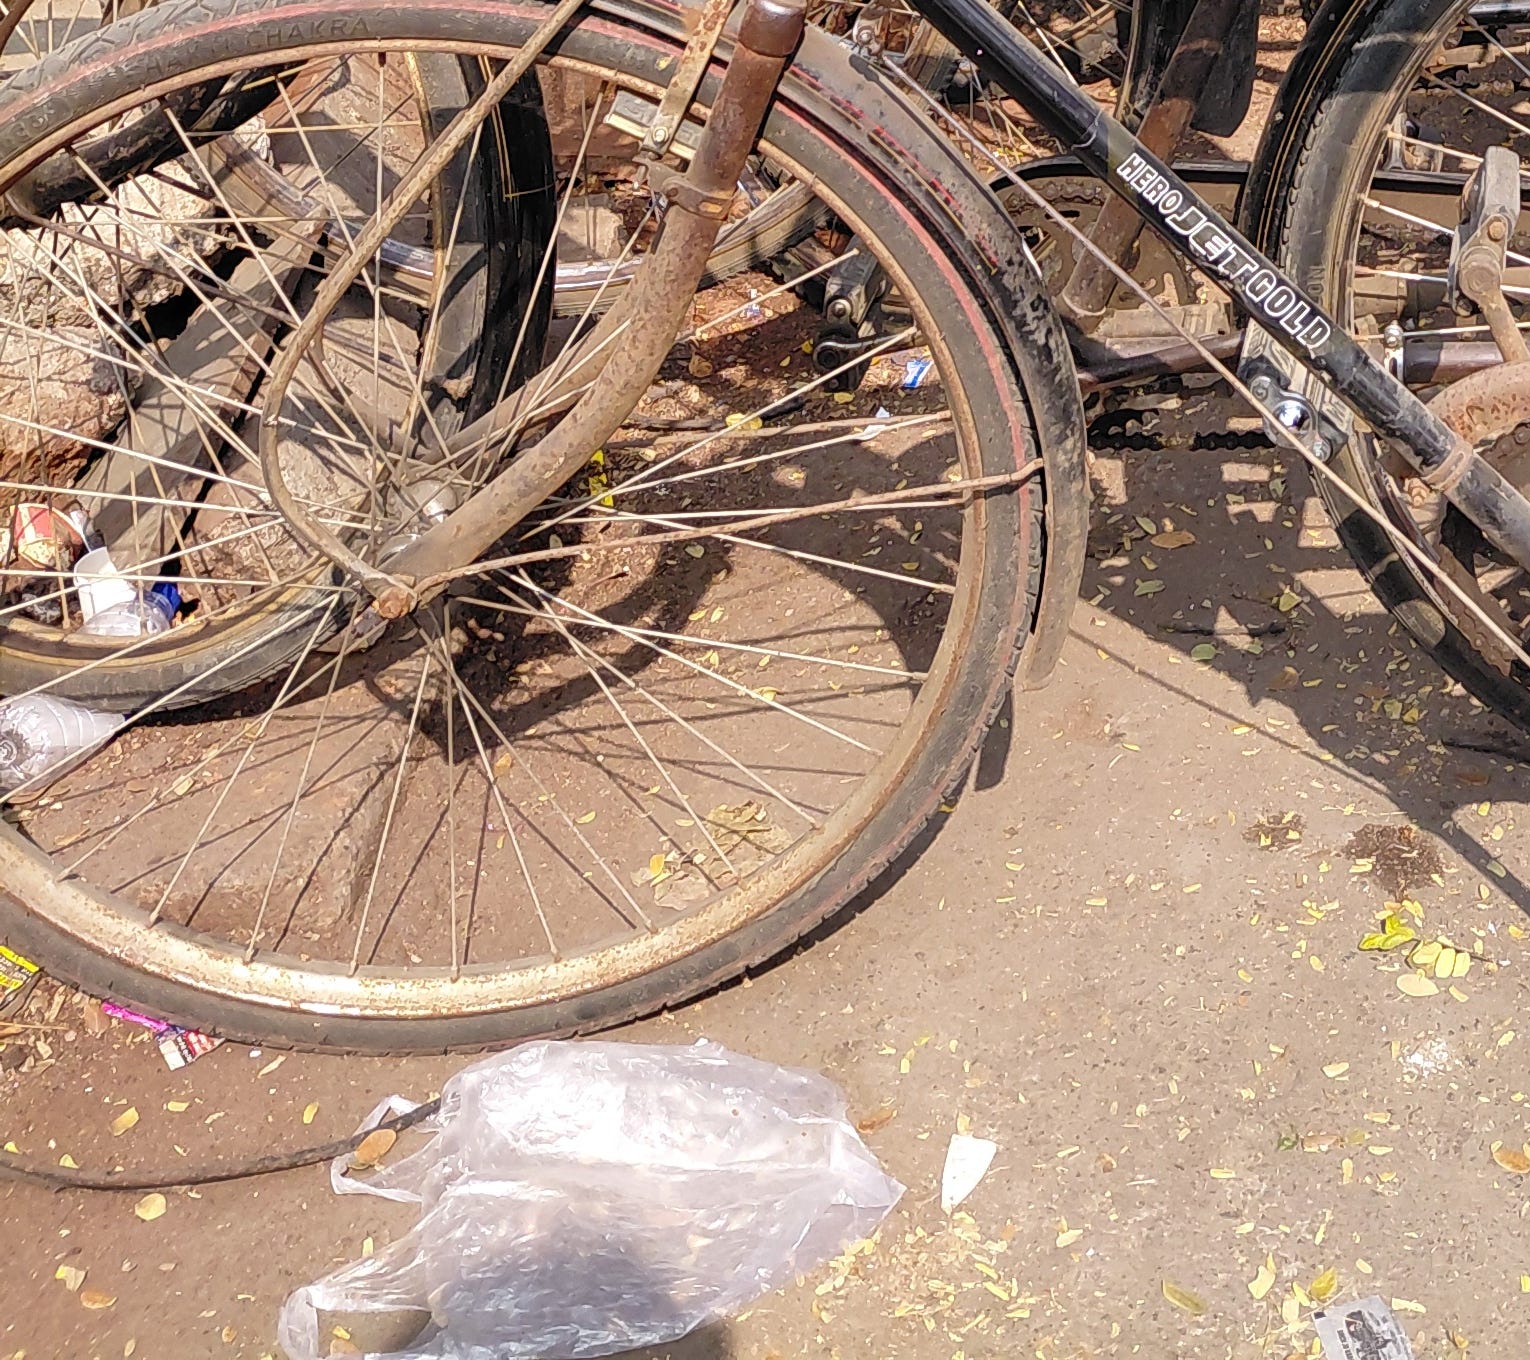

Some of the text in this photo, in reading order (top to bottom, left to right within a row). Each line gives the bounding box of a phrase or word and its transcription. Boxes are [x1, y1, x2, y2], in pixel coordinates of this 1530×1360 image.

[1116, 152, 1184, 215] HERO
[1165, 205, 1260, 281] JET
[1245, 268, 1332, 350] GOLD
